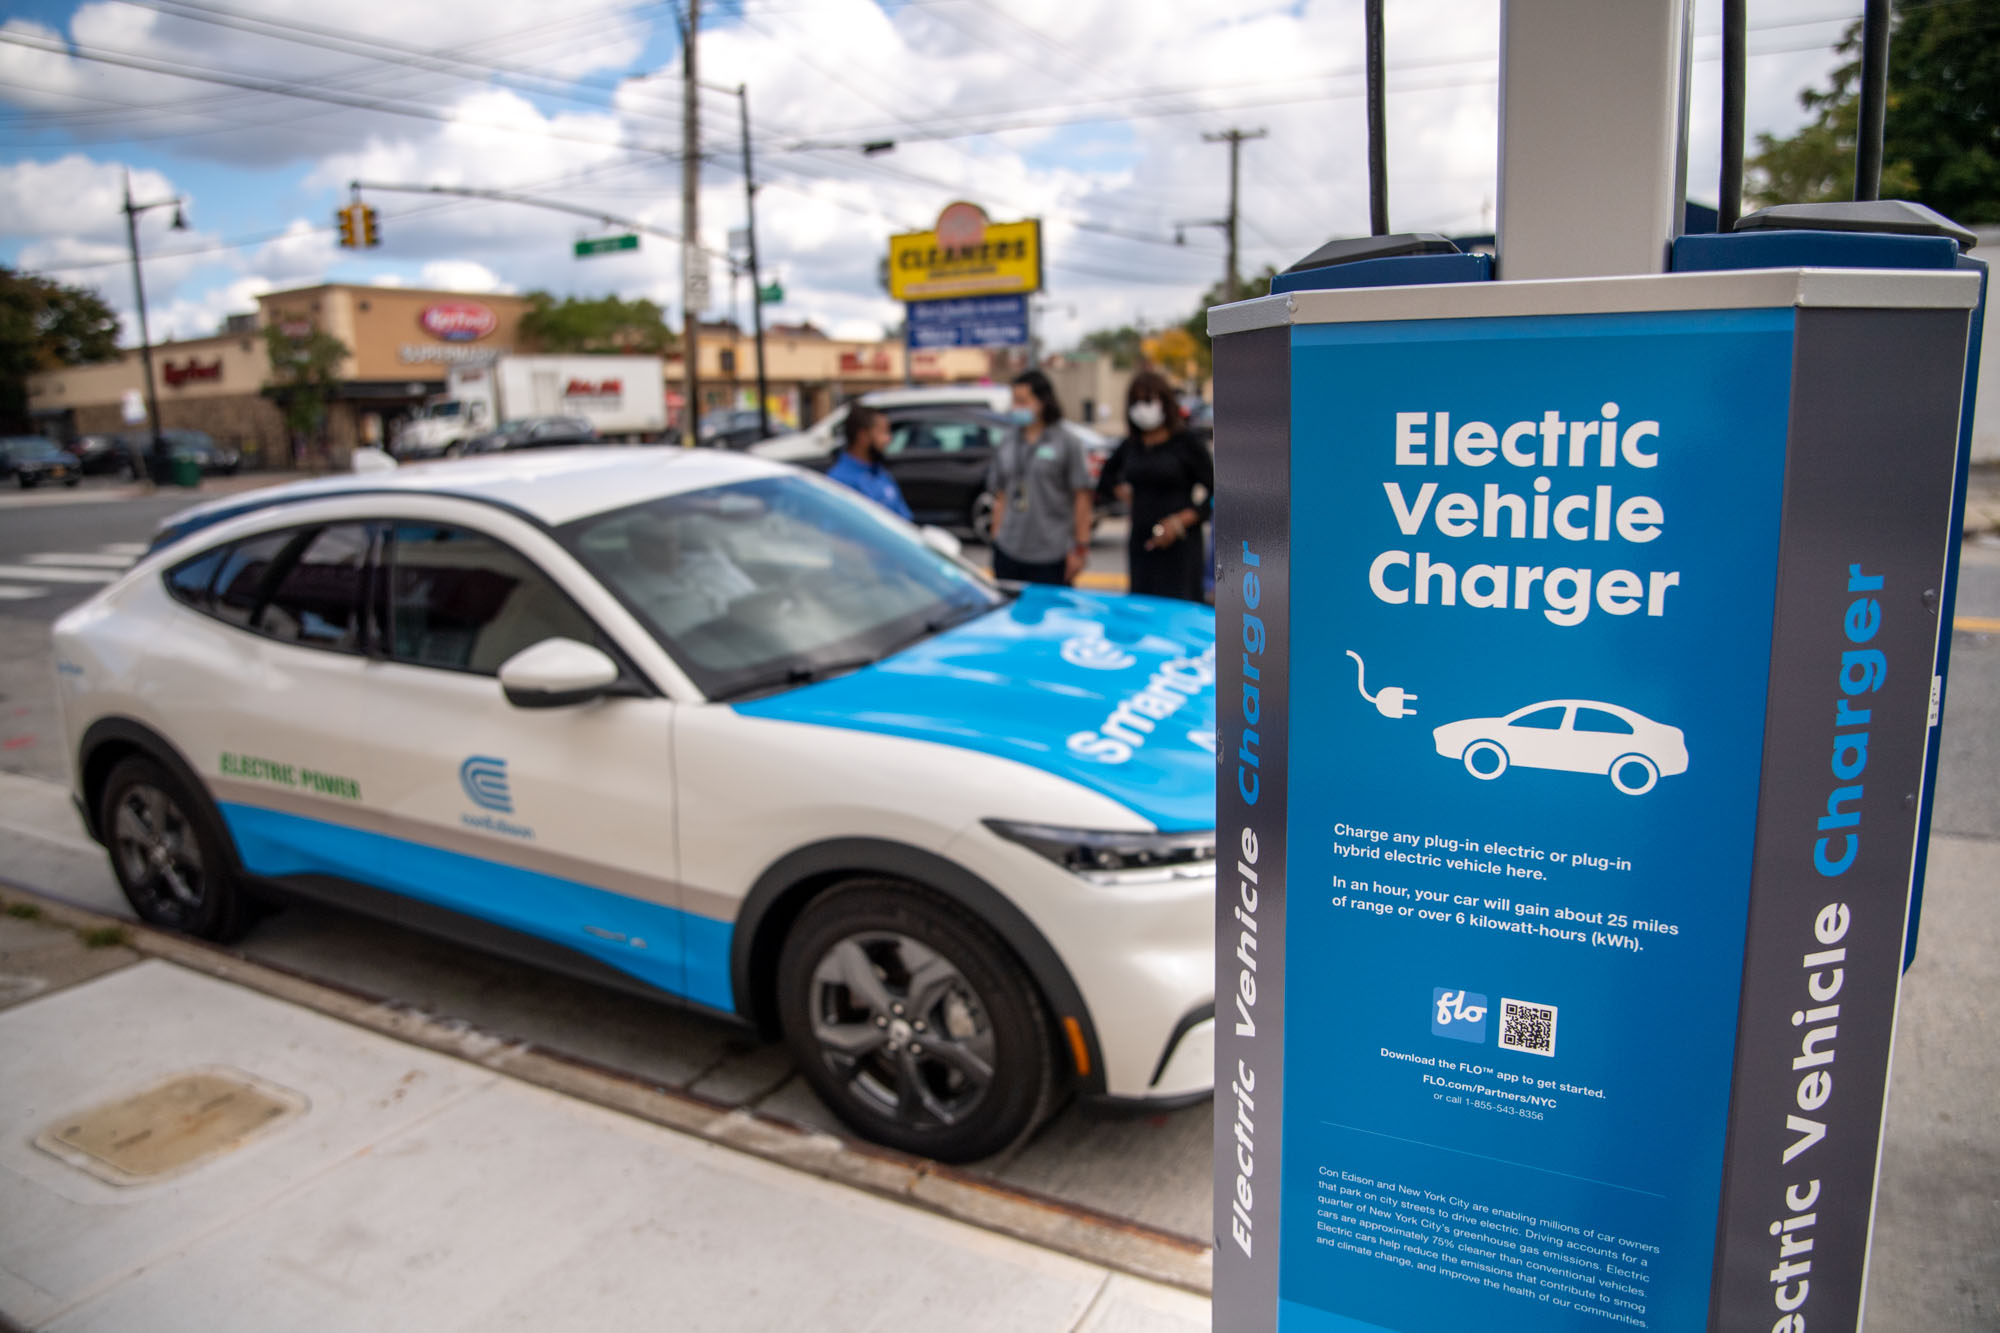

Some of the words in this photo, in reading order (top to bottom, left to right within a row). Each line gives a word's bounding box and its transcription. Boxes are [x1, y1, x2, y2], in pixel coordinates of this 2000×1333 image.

[898, 238, 1027, 270] CLEANERS
[1394, 402, 1660, 468] Electric
[1383, 476, 1665, 543] Vehicle
[1368, 549, 1681, 627] Charger
[1238, 540, 1266, 806] Charger
[1813, 562, 1888, 878] Charger
[219, 752, 297, 786] ELECTRIC
[301, 769, 362, 800] POWER
[1333, 823, 1389, 842] Charge
[1392, 832, 1421, 847] any
[1424, 834, 1480, 852] plug-in
[1483, 841, 1545, 860] electric
[1549, 852, 1568, 863] or
[1571, 852, 1632, 871] plug-in
[1333, 842, 1380, 859] hybrid
[1383, 849, 1442, 867] electric
[1445, 858, 1502, 875] vehicle
[1506, 863, 1547, 881] here.
[1235, 826, 1260, 1037] Vehicle
[1331, 895, 1348, 907] of
[1350, 899, 1394, 915] range
[1397, 906, 1415, 917] or
[1417, 909, 1452, 922] over
[1455, 911, 1466, 924] 6
[1469, 913, 1587, 942] kilowatt-hours
[1591, 931, 1644, 952] (kWh).
[1332, 875, 1346, 888] In
[1350, 880, 1369, 891] an
[1372, 880, 1411, 899] hour,
[1414, 889, 1450, 902] your
[1452, 895, 1480, 907] car
[1482, 898, 1510, 911] will
[1514, 903, 1550, 917] gain
[1553, 907, 1603, 925] about
[1606, 913, 1628, 928] 25
[1632, 919, 1679, 935] miles
[1436, 990, 1488, 1025] flo
[1782, 902, 1851, 1165] Vehicle
[1380, 1047, 1436, 1066] Download
[1437, 1058, 1457, 1070] the
[1496, 1071, 1520, 1083] app
[1521, 1074, 1534, 1085] to
[1536, 1079, 1557, 1089] get
[1559, 1083, 1606, 1099] started.
[1422, 1074, 1557, 1108] FLO.com/Partners/NYC
[1445, 1095, 1463, 1104] call
[1465, 1098, 1544, 1121] 1-855-543-8356
[1232, 1058, 1256, 1259] Electric
[1317, 1180, 1337, 1192] that
[1339, 1186, 1362, 1198] park
[1363, 1192, 1378, 1201] on
[1379, 1196, 1398, 1207] city
[1400, 1201, 1436, 1215] streets
[1438, 1208, 1449, 1218] to
[1451, 1212, 1478, 1225] drive
[1479, 1220, 1522, 1235] electric.
[1525, 1228, 1564, 1248] Driving
[1566, 1240, 1618, 1259] accounts
[1621, 1252, 1638, 1263] for
[1317, 1195, 1354, 1209] quarter
[1355, 1204, 1367, 1212] of
[1369, 1205, 1392, 1219] New
[1394, 1212, 1418, 1225] York
[1452, 1228, 1516, 1249] greenhouse
[1519, 1244, 1540, 1255] gas
[1542, 1250, 1601, 1270] emissions.
[1606, 1263, 1649, 1282] Electric
[1318, 1166, 1339, 1178] Con
[1340, 1170, 1374, 1186] Edison
[1376, 1181, 1396, 1192] and
[1398, 1184, 1421, 1197] New
[1423, 1189, 1446, 1203] York
[1448, 1196, 1470, 1210] City
[1472, 1203, 1490, 1213] are
[1491, 1208, 1537, 1226] enabling
[1539, 1219, 1580, 1235] millions
[1582, 1229, 1595, 1238] of
[1596, 1233, 1616, 1242] car
[1618, 1238, 1660, 1254] owners
[1315, 1236, 1335, 1247] and
[1336, 1241, 1372, 1256] climate
[1374, 1250, 1414, 1268] change,
[1416, 1262, 1437, 1273] and
[1438, 1266, 1481, 1284] improve
[1483, 1278, 1500, 1289] the
[1502, 1282, 1536, 1298] health
[1538, 1293, 1550, 1302] of
[1552, 1297, 1572, 1307] our
[1573, 1303, 1648, 1328] communities.
[1316, 1209, 1339, 1220] cars
[1340, 1214, 1357, 1224] are
[1358, 1219, 1430, 1244] approximately
[1432, 1235, 1455, 1248] 75%
[1457, 1243, 1497, 1258] cleaner
[1498, 1252, 1523, 1265] than
[1525, 1260, 1596, 1284] conventional
[1598, 1279, 1647, 1296] vehicles.
[1316, 1220, 1353, 1238] Electric
[1354, 1232, 1377, 1244] cars
[1378, 1236, 1401, 1250] help
[1402, 1244, 1439, 1259] reduce
[1441, 1252, 1458, 1264] the
[1460, 1259, 1514, 1278] emissions
[1516, 1271, 1537, 1284] that
[1539, 1279, 1596, 1299] contribute
[1599, 1293, 1611, 1303] to
[1613, 1298, 1646, 1314] smog
